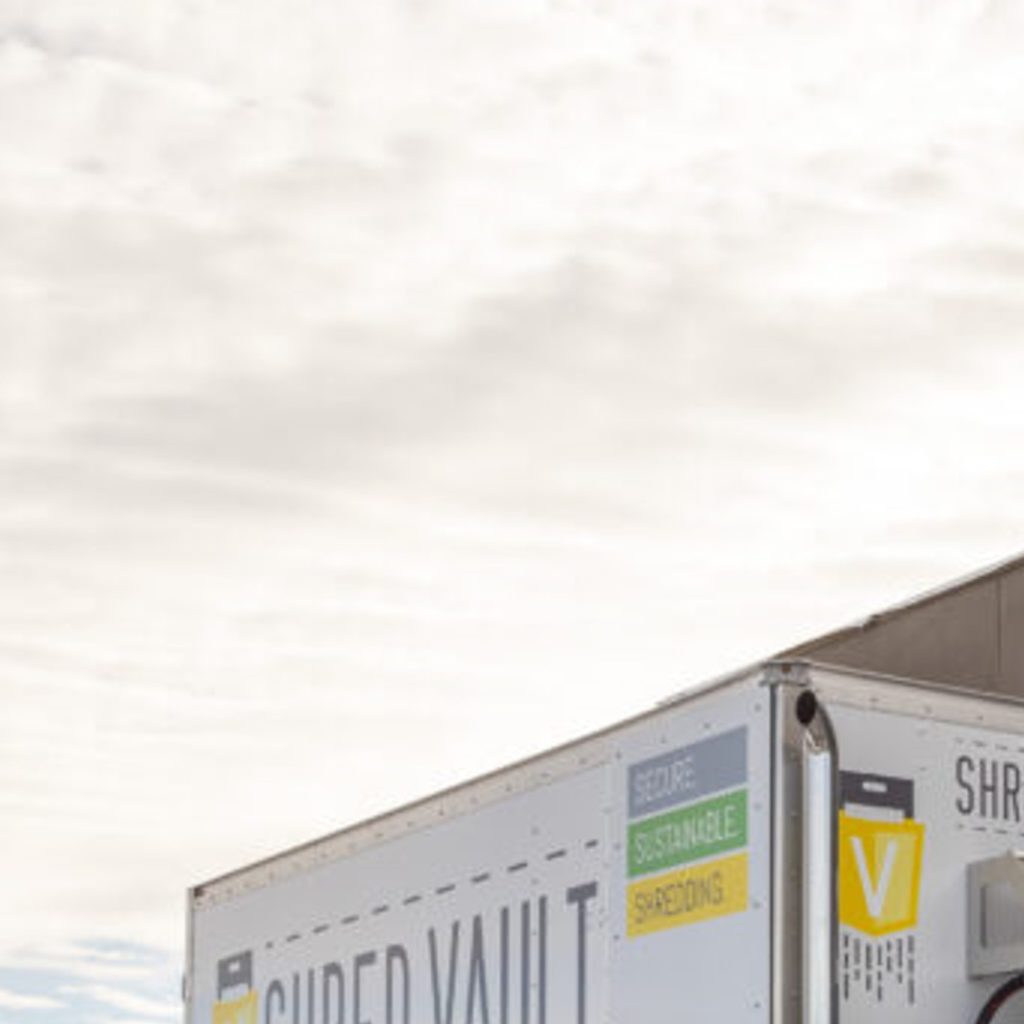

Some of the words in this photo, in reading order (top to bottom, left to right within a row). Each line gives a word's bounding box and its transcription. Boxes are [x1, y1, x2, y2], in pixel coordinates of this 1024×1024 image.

[634, 756, 697, 805] SECURE
[634, 805, 739, 865] SUSTAINABLE
[633, 869, 724, 925] SHREDDING
[850, 836, 897, 918] V
